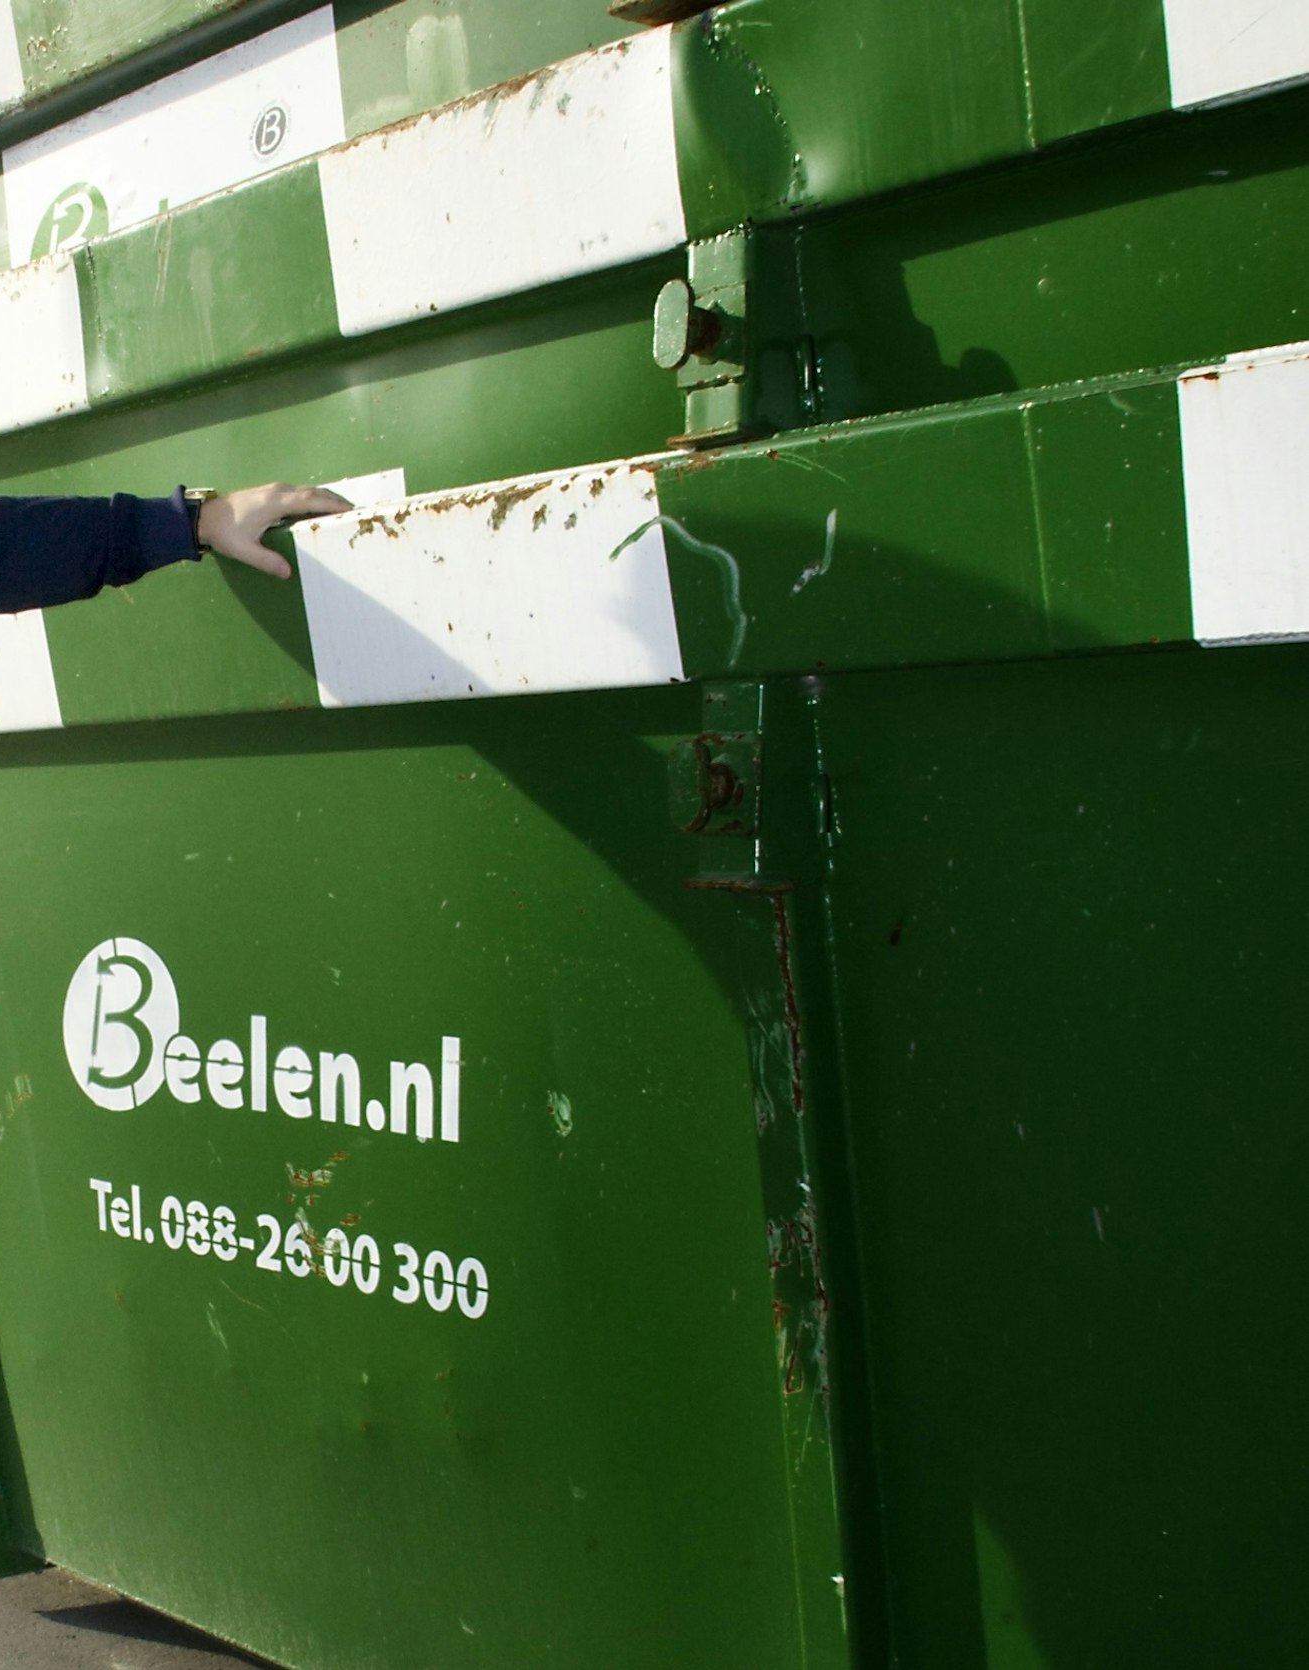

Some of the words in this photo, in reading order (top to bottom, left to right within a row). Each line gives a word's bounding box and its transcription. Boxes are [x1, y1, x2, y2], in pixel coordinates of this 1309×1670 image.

[63, 936, 461, 1143] Beelen.nl
[89, 1177, 155, 1245] Tel.
[392, 1242, 489, 1320] 300
